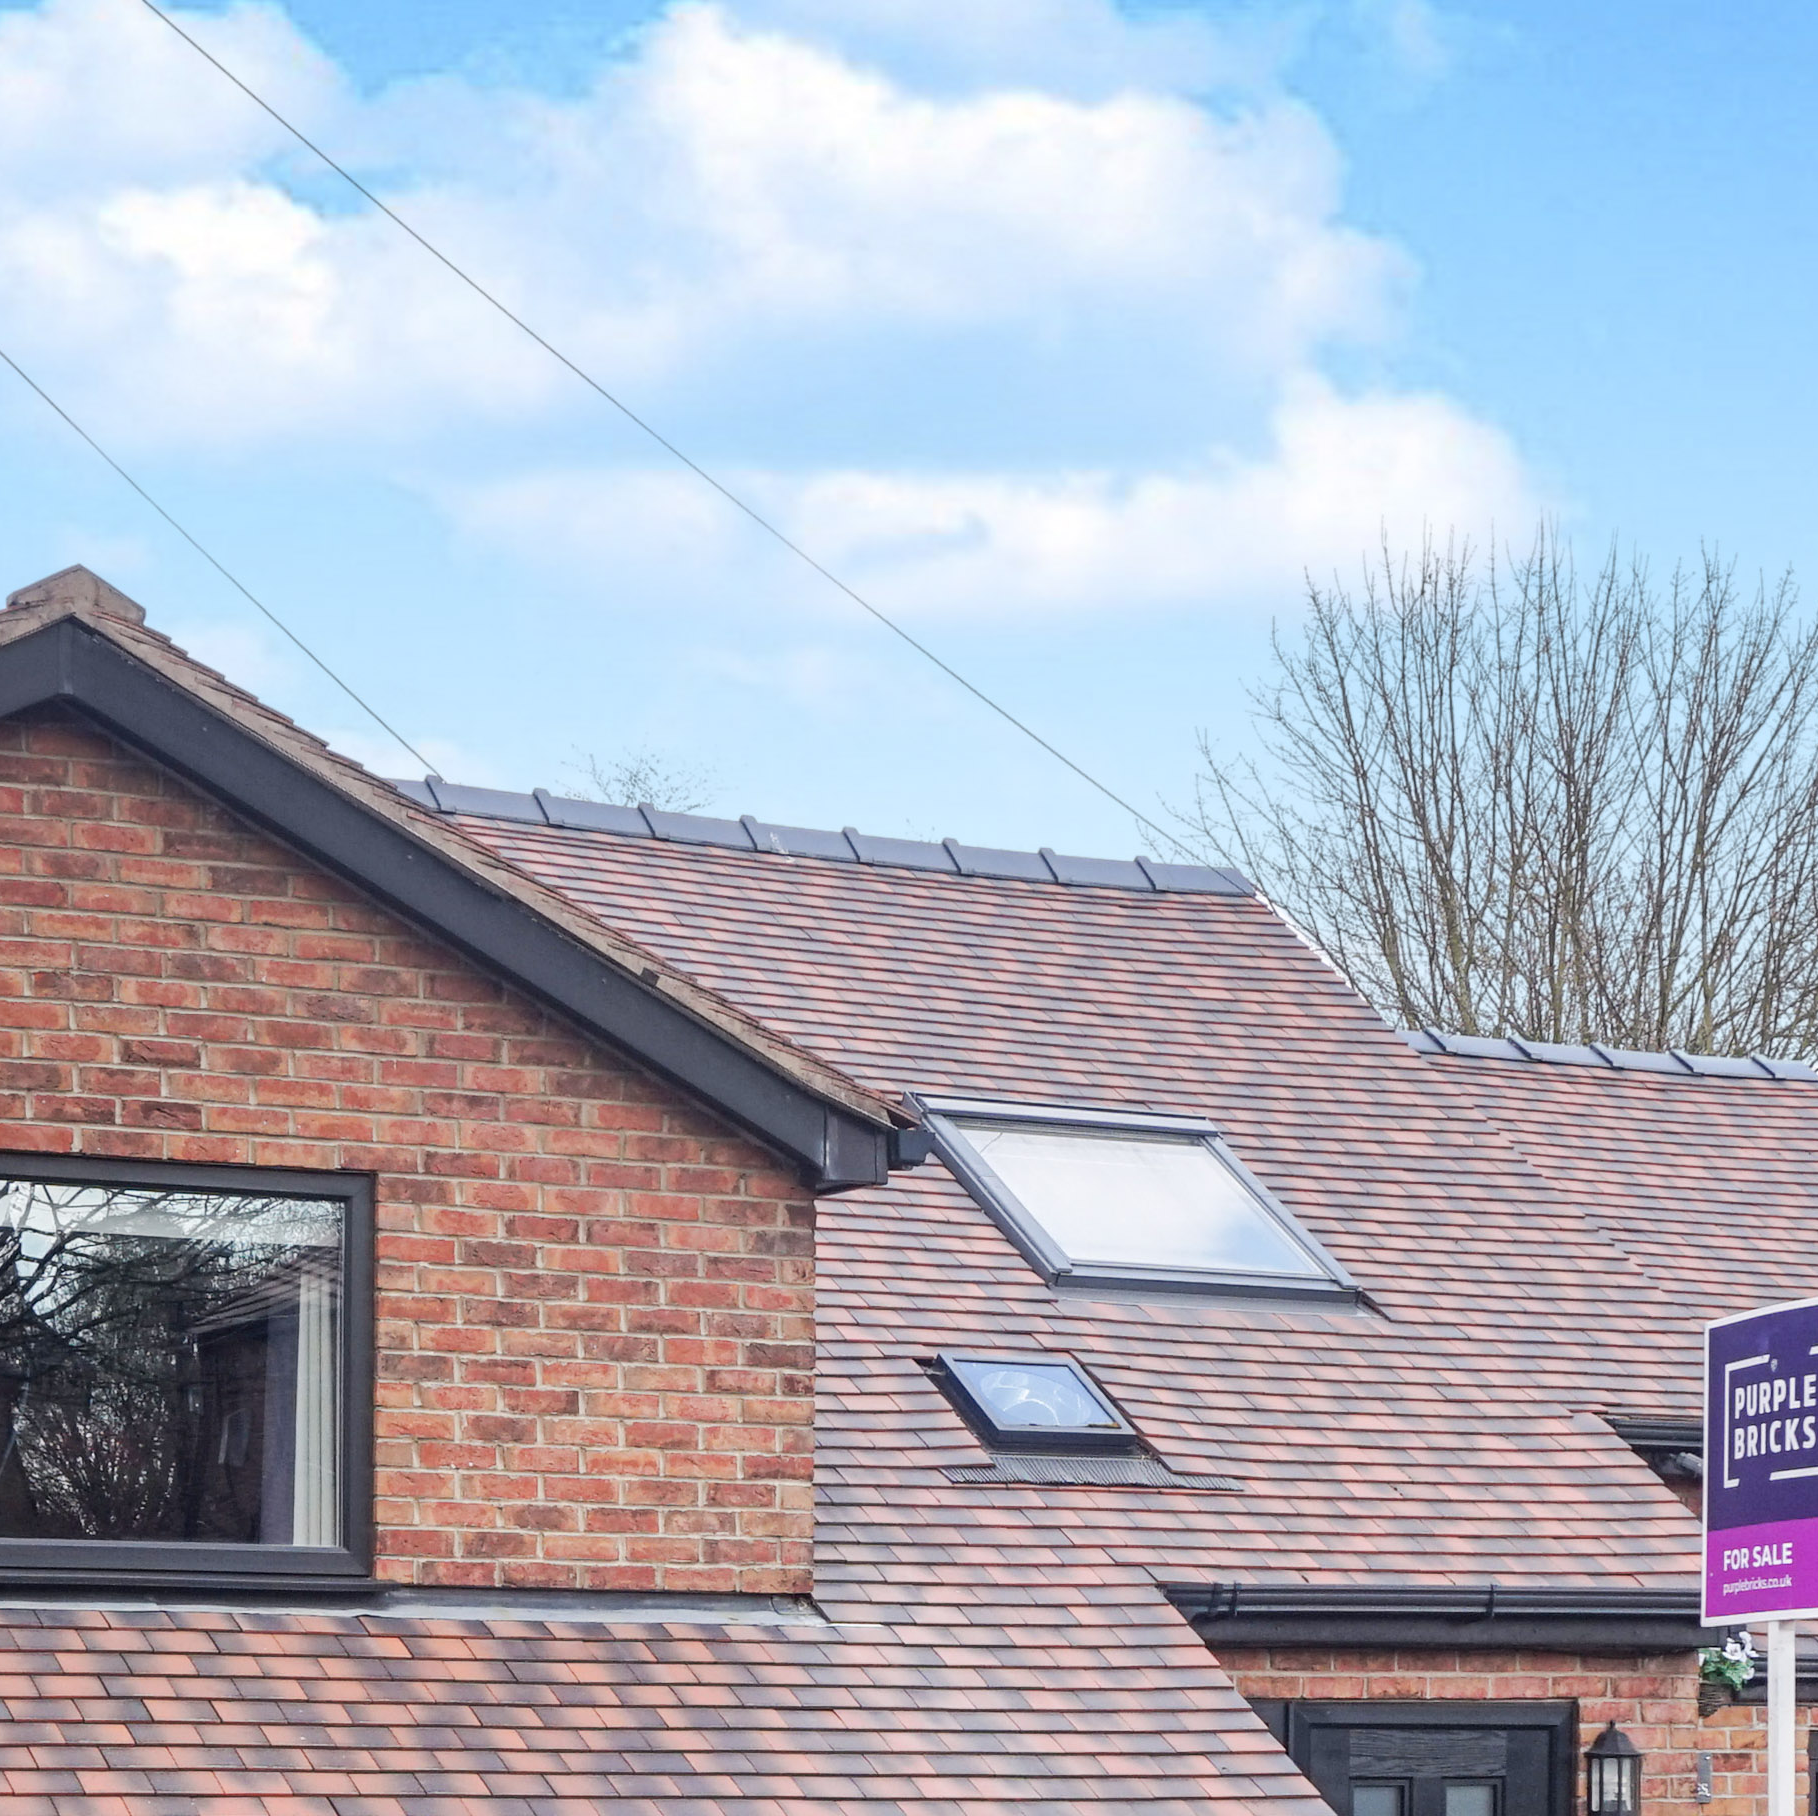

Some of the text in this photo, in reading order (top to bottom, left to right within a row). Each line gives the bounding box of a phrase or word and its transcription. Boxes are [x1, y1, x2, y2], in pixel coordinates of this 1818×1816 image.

[1734, 1373, 1817, 1420] PURPLE
[1733, 1415, 1817, 1460] BRICKS
[1723, 1542, 1793, 1572] FOR SALE
[1722, 1574, 1793, 1597] purplebricks.co.uk
